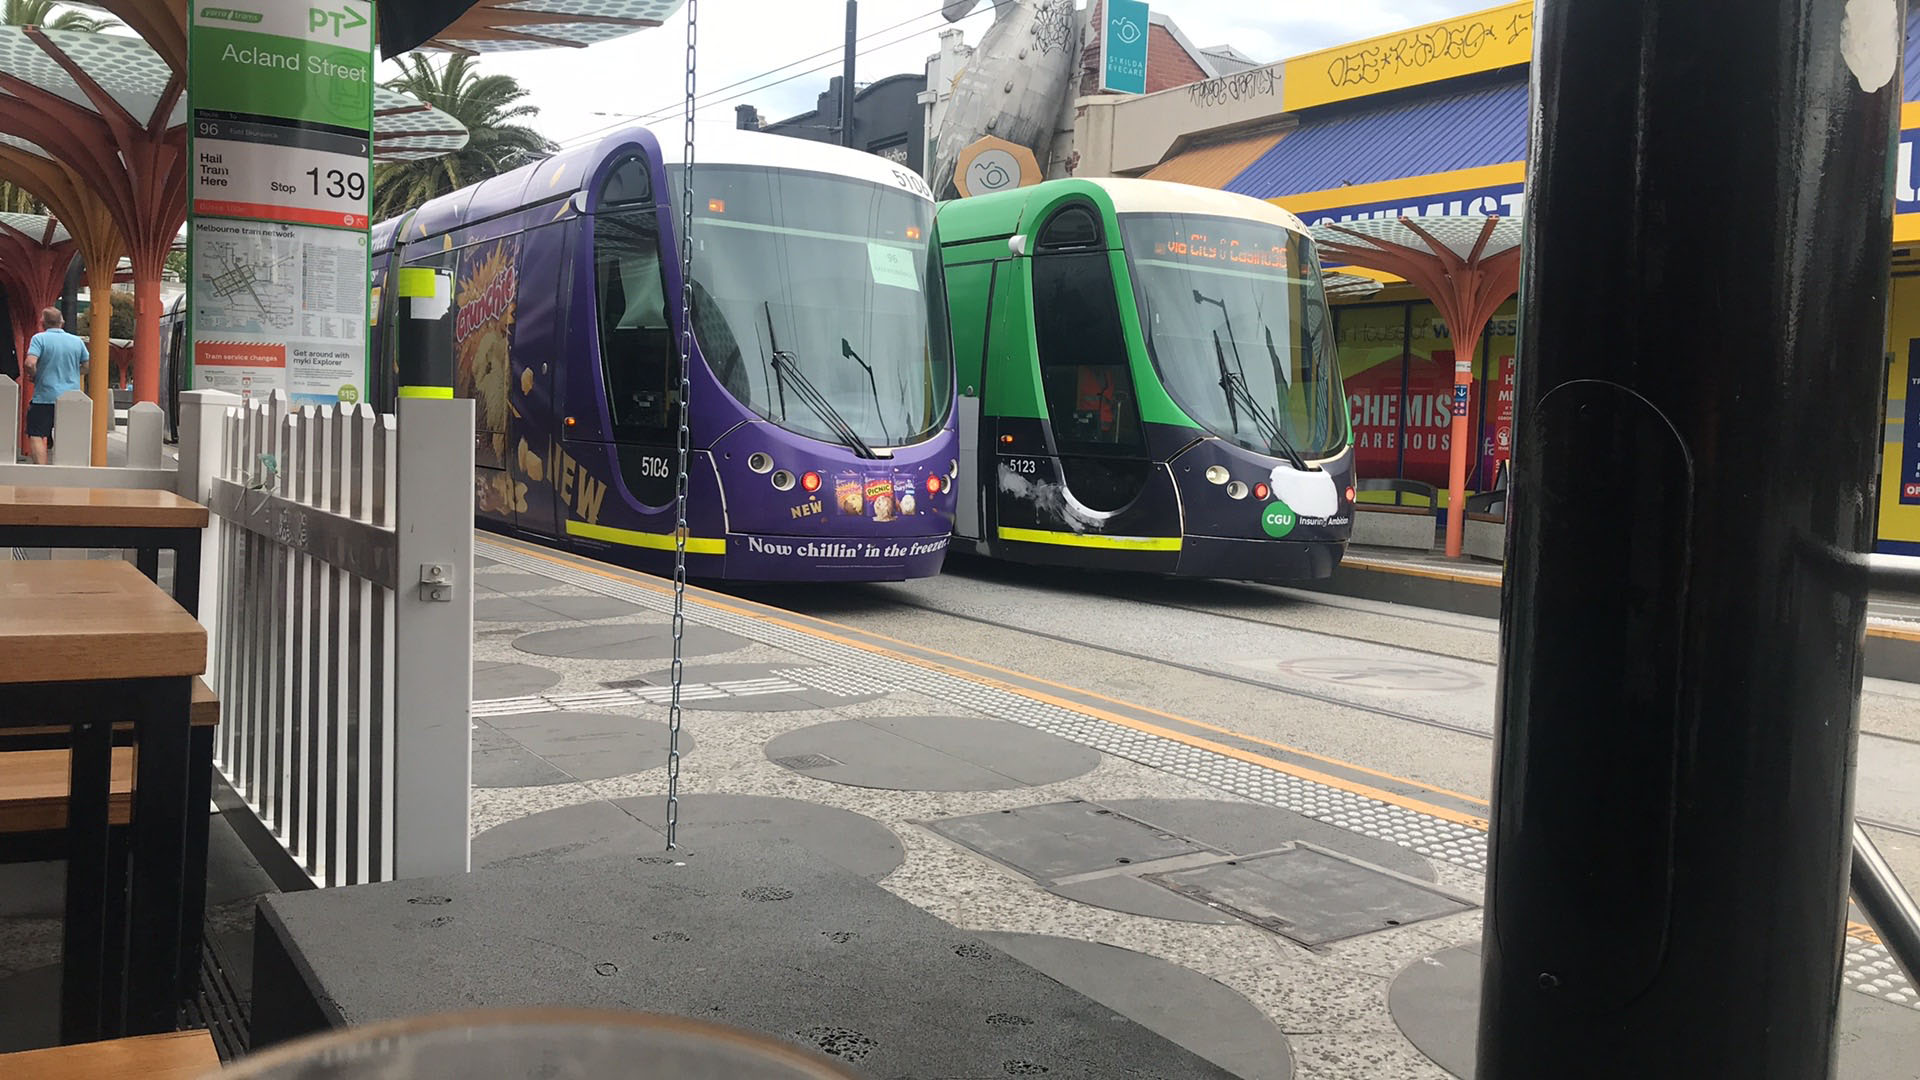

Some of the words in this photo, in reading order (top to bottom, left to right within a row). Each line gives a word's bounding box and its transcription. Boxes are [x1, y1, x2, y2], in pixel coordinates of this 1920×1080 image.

[222, 43, 300, 71] Acland
[307, 55, 367, 83] Street
[1120, 57, 1143, 68] KILDA
[1108, 64, 1143, 77] EYECARE
[200, 122, 219, 136] 96
[200, 153, 222, 163] Hail
[200, 164, 229, 175] Tram
[200, 176, 228, 186] Here
[270, 182, 297, 194] Stop
[306, 167, 365, 200] 139
[891, 169, 930, 198] 5106
[196, 224, 240, 234] Melbourne
[241, 227, 262, 236] tram
[262, 229, 295, 238] network
[204, 352, 222, 360] Tram
[250, 354, 278, 363] changes
[293, 350, 307, 358] Get
[308, 350, 333, 359] around
[334, 351, 350, 359] with
[293, 358, 312, 367] myki
[312, 358, 343, 367] Explorer
[1347, 394, 1452, 428] CHEMIS
[1010, 459, 1036, 473] 5123
[546, 434, 607, 525] NEW
[867, 485, 890, 495] PICNIC
[790, 500, 823, 519] NEW
[1266, 514, 1291, 525] CGU
[748, 537, 792, 555] Now
[864, 544, 880, 558] in
[884, 543, 907, 557] the
